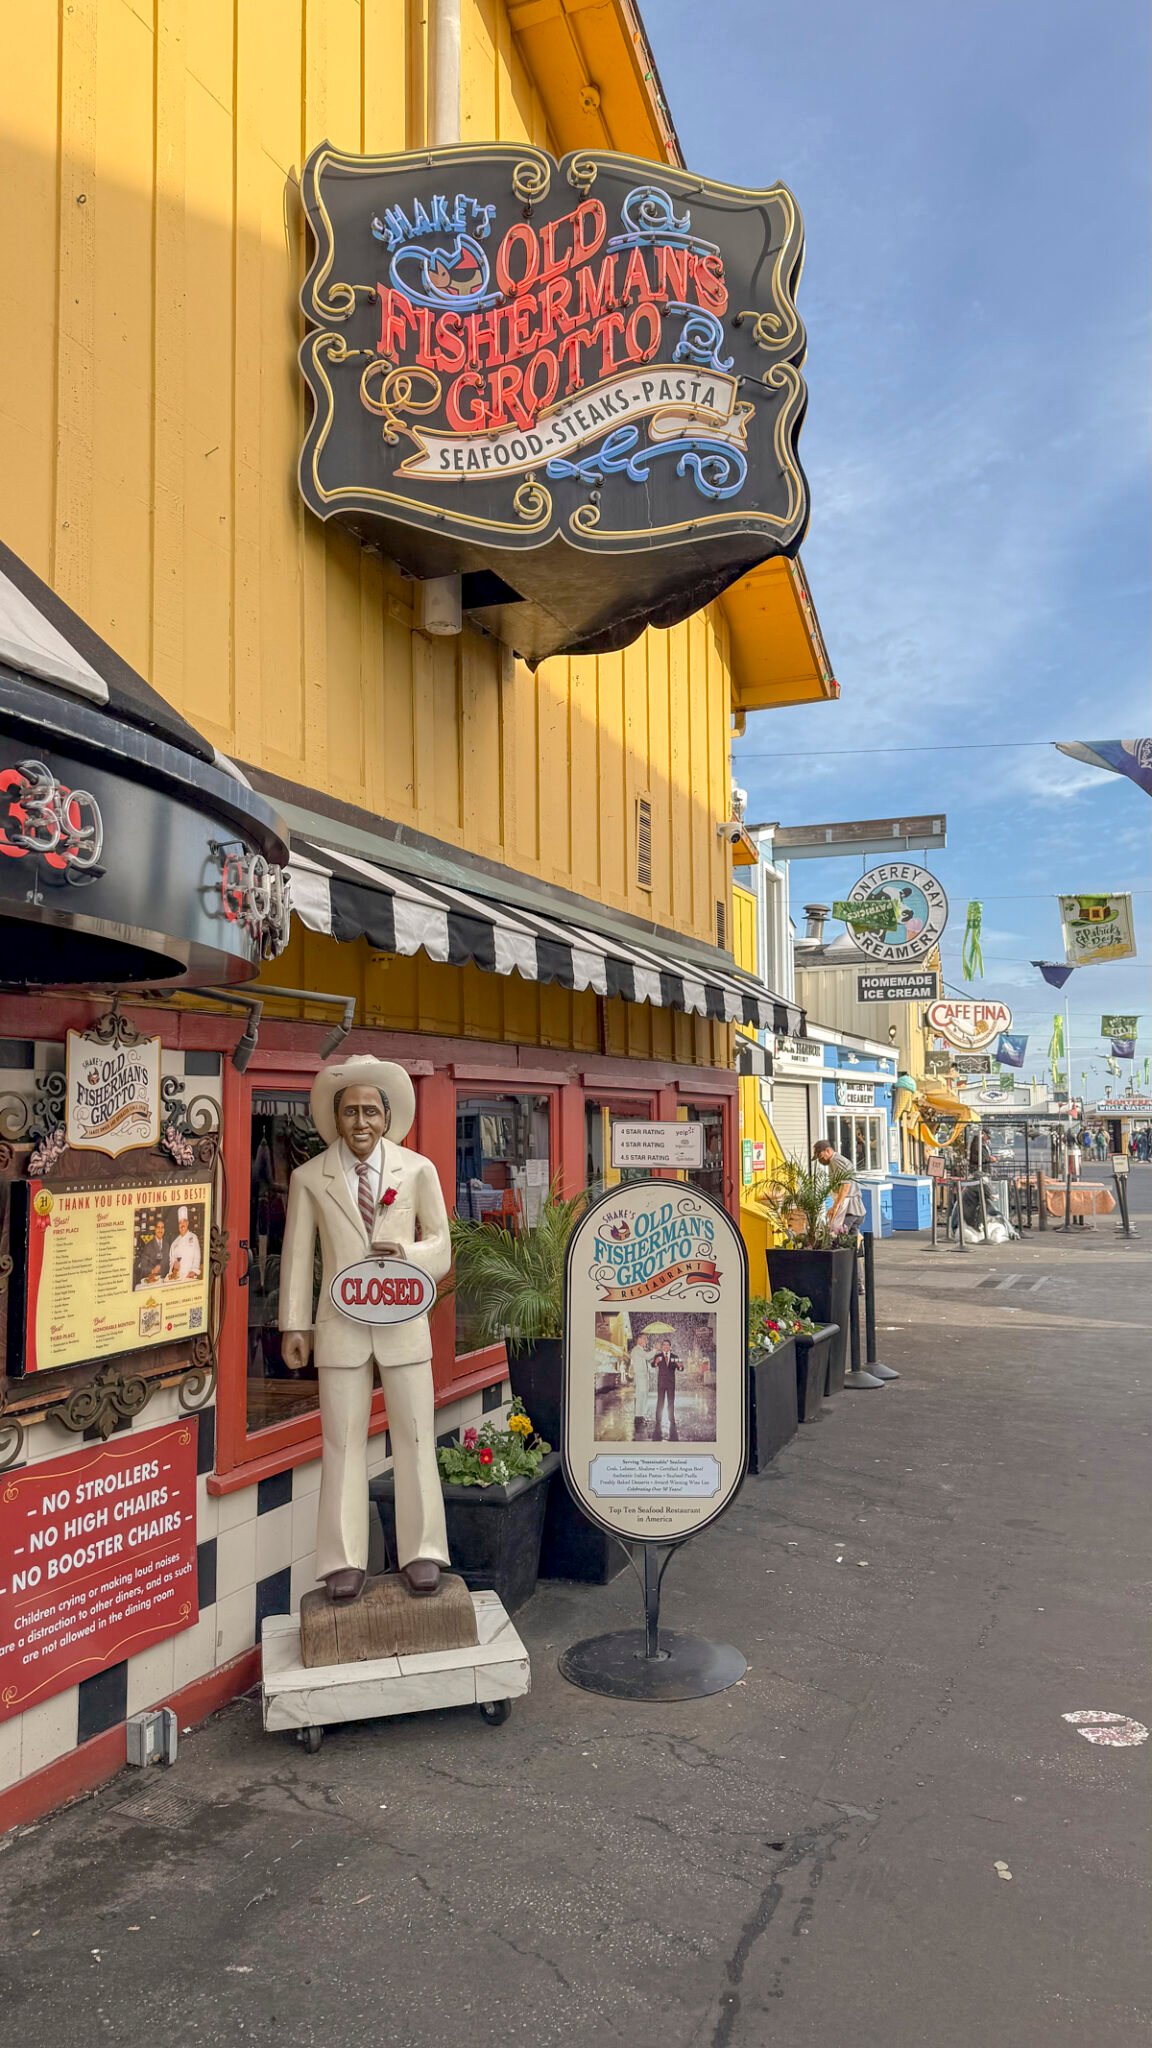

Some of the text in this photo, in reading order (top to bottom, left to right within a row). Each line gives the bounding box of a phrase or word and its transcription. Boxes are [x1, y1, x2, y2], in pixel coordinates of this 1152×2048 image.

[496, 198, 607, 297] OLD
[376, 245, 728, 373] FISHERMAN'S
[446, 302, 662, 432] GROTTO
[852, 866, 944, 909] ONTEREY BAY
[861, 975, 933, 988] HOMEMADE
[863, 987, 931, 999] ICE CREAM
[931, 1004, 1007, 1027] CAFE FINA
[77, 1065, 148, 1106] FISHERMAN'S
[102, 1053, 125, 1082] OLD
[91, 1084, 135, 1124] GROTTO
[59, 1187, 206, 1210] THANK YOU FOR VOTING US BEST!
[602, 1209, 636, 1223] SHAKE'S
[593, 1217, 715, 1265] FISHERMAN'S
[634, 1203, 673, 1238] OLD
[617, 1238, 692, 1286] GROTTO
[621, 1263, 701, 1298] RESTAURANT
[341, 1277, 424, 1305] CLOSED
[42, 1459, 159, 1516] NO STROLLERS
[30, 1486, 168, 1553] NO HIGH CHAIRS
[608, 1506, 621, 1514] Top
[12, 1511, 182, 1594] NO BOOSTER CHAIRS
[14, 1553, 180, 1630] Children crying or making loud noises
[18, 1638, 25, 1648] a
[27, 1614, 76, 1643] distraction
[78, 1610, 88, 1620] to
[90, 1598, 113, 1615] other
[115, 1586, 144, 1604] diners,
[146, 1574, 162, 1590] and
[163, 1573, 173, 1582] as
[174, 1562, 192, 1578] such
[22, 1588, 175, 1664] are not allowed in the dining room
